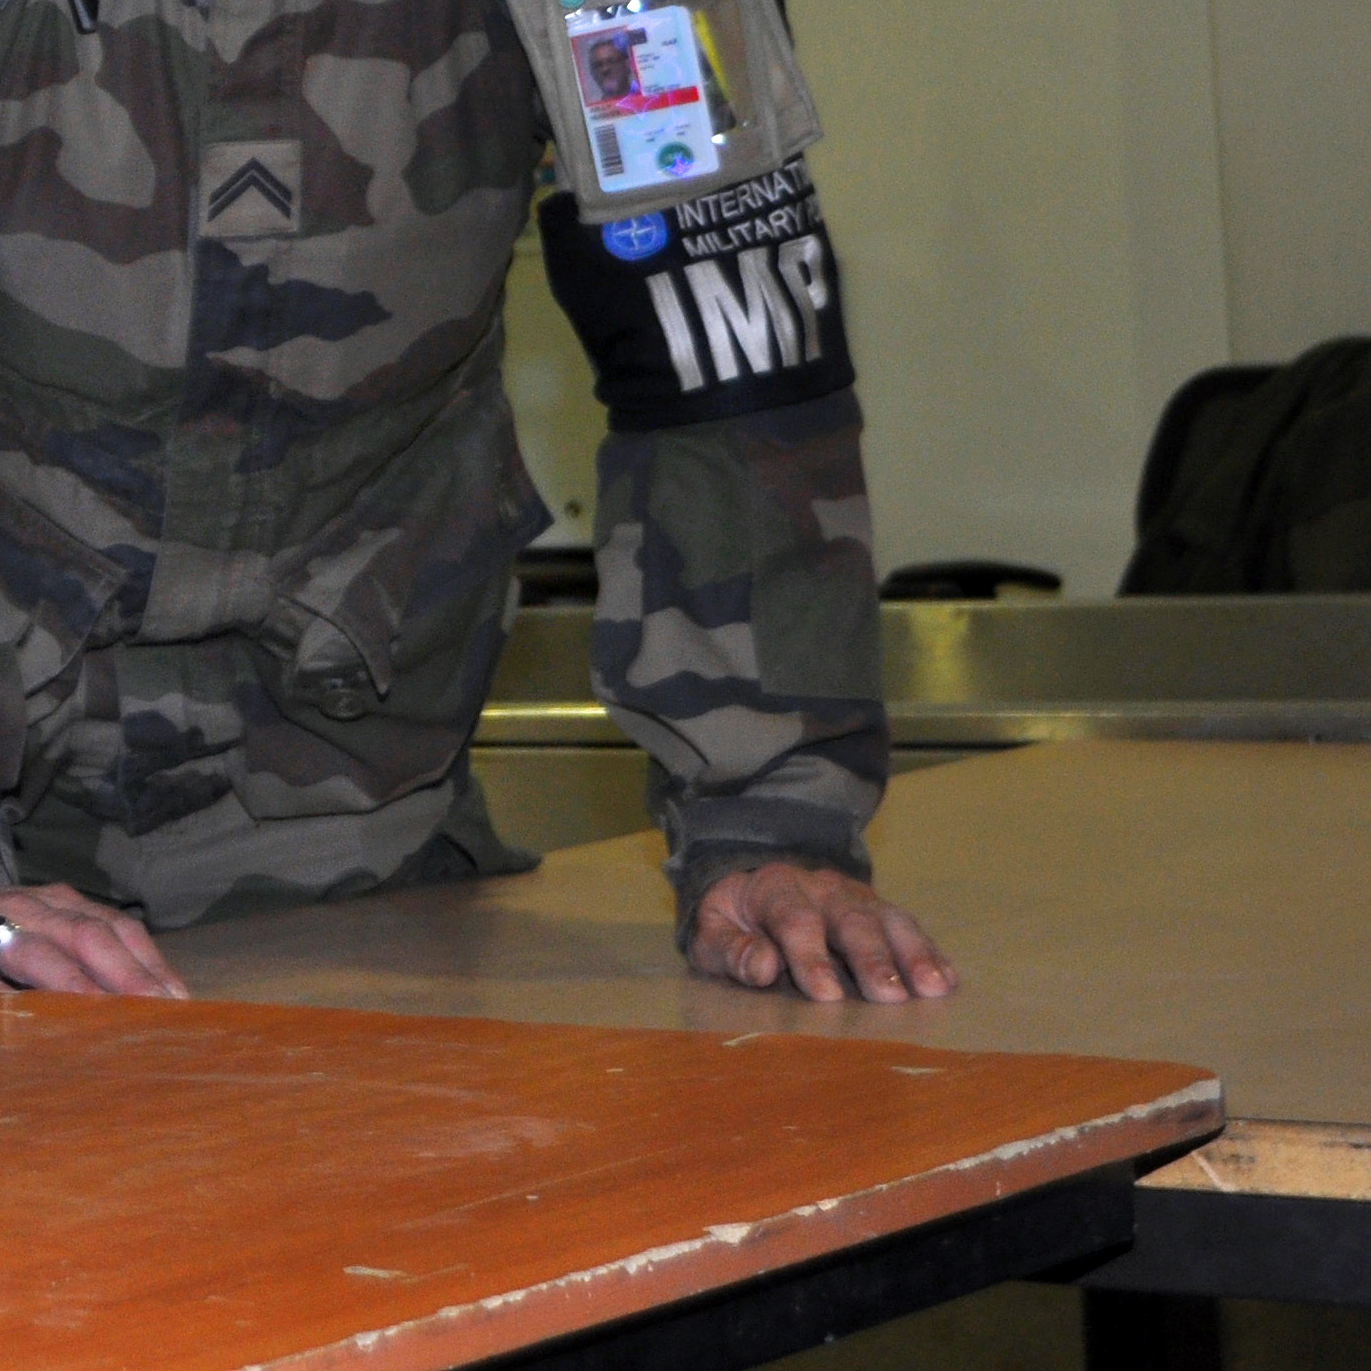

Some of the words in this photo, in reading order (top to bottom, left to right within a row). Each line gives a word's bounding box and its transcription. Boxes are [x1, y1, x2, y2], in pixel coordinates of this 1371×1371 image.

[674, 158, 805, 230] INTERNAT
[681, 201, 802, 258] MILITARY
[645, 234, 827, 393] IMP
